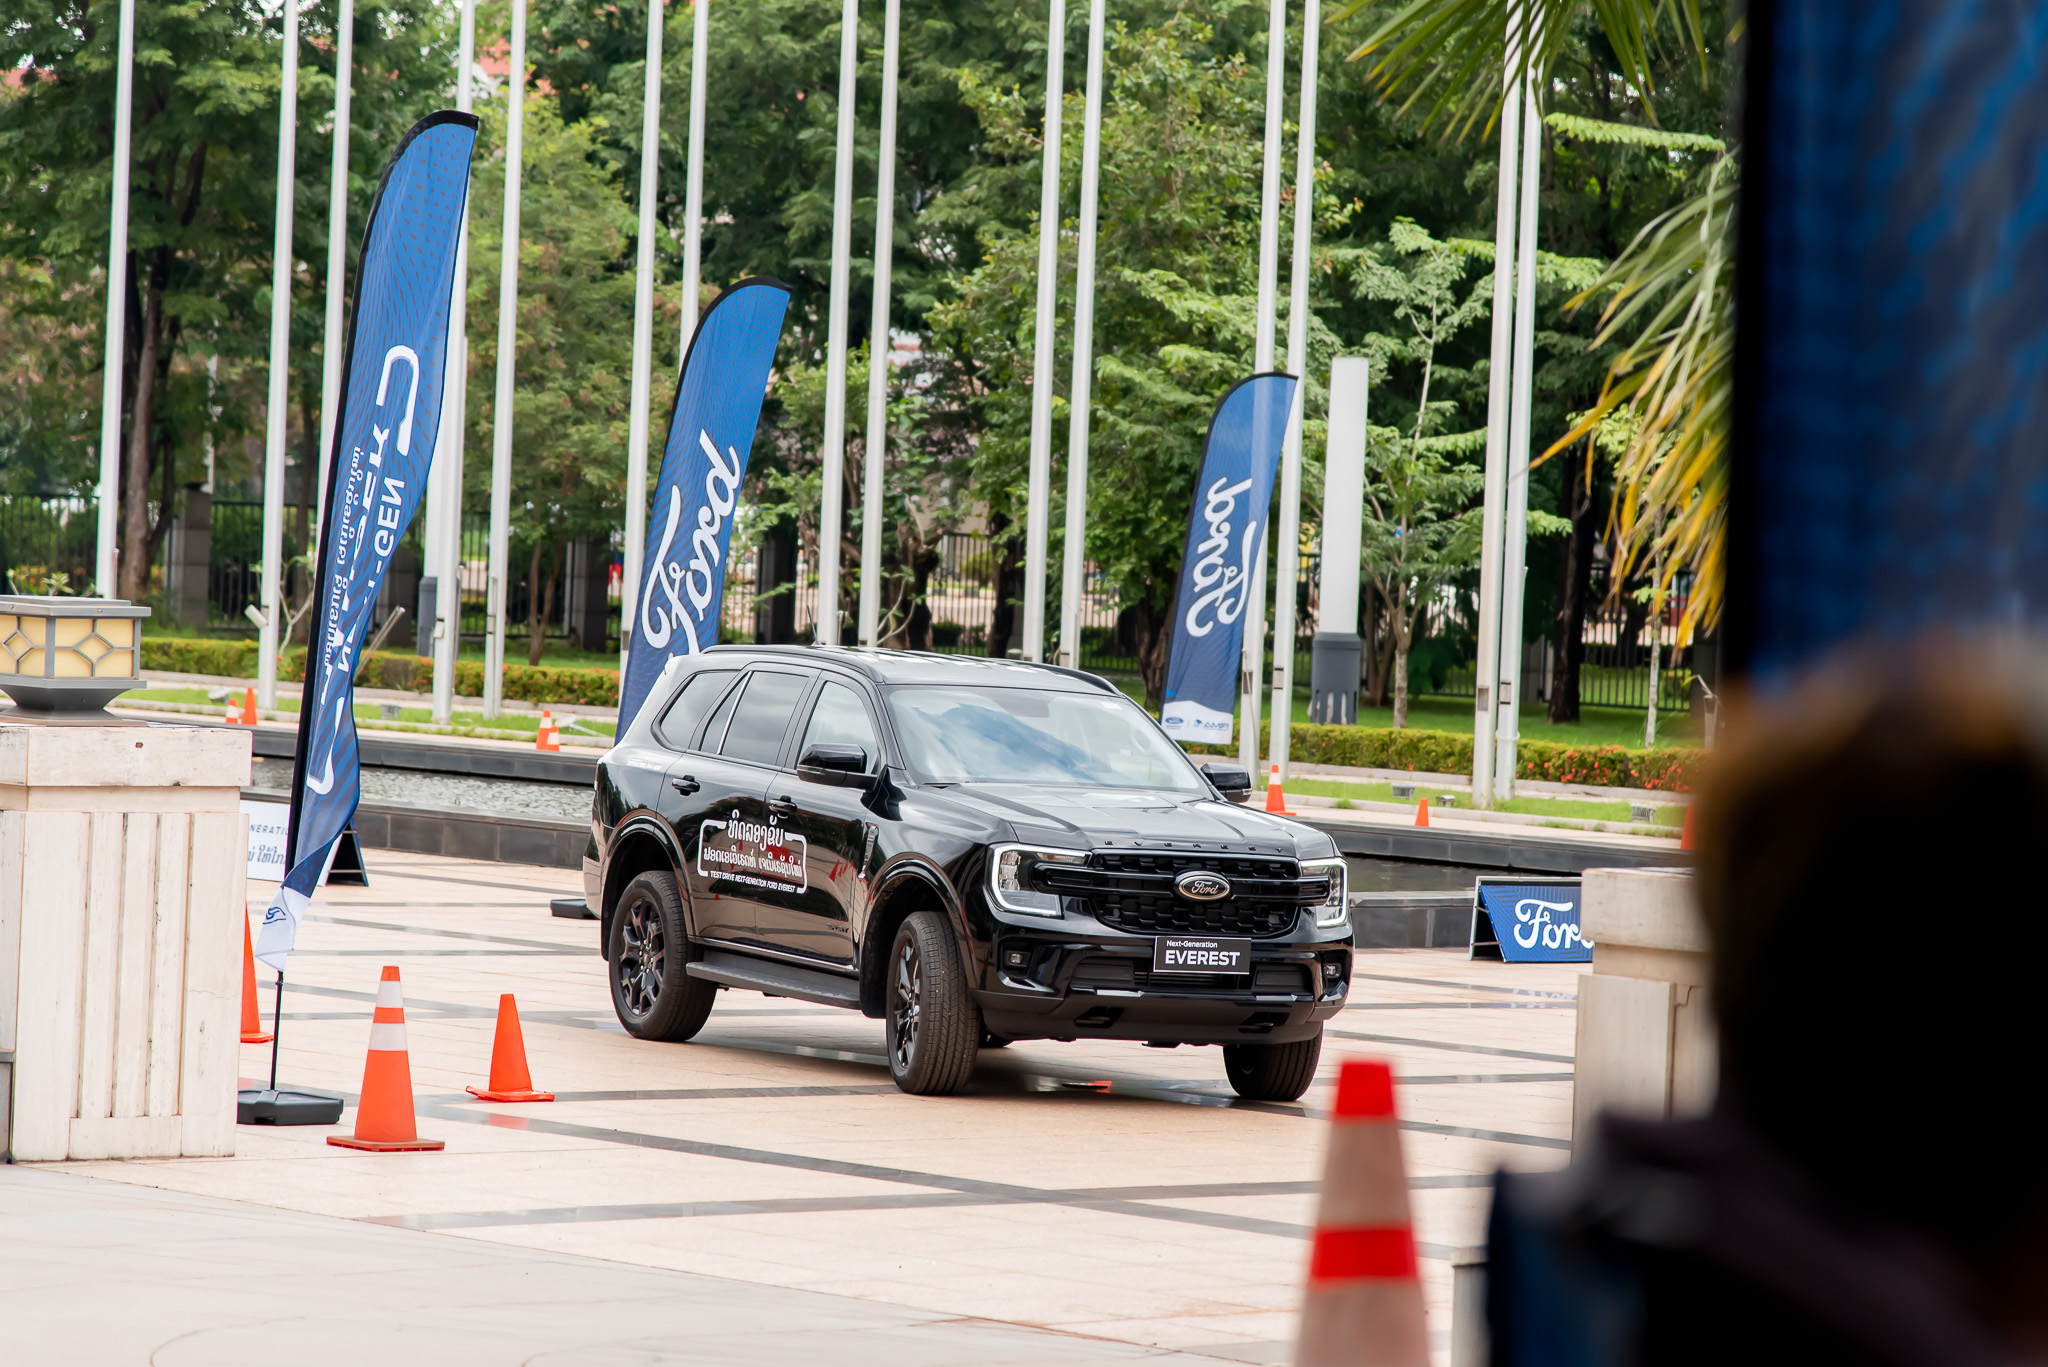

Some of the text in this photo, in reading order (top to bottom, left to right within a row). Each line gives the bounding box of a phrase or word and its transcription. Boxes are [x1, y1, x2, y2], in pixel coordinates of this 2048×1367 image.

[642, 428, 741, 656] Ford
[710, 870, 722, 879] TEST
[722, 872, 735, 881] DRIVE
[767, 880, 778, 889] FORD
[778, 882, 796, 892] EVEREST
[1191, 880, 1218, 895] Ford
[1513, 898, 1595, 949] For
[1166, 940, 1218, 949] Next-Generation
[1165, 949, 1240, 966] EVEREST
